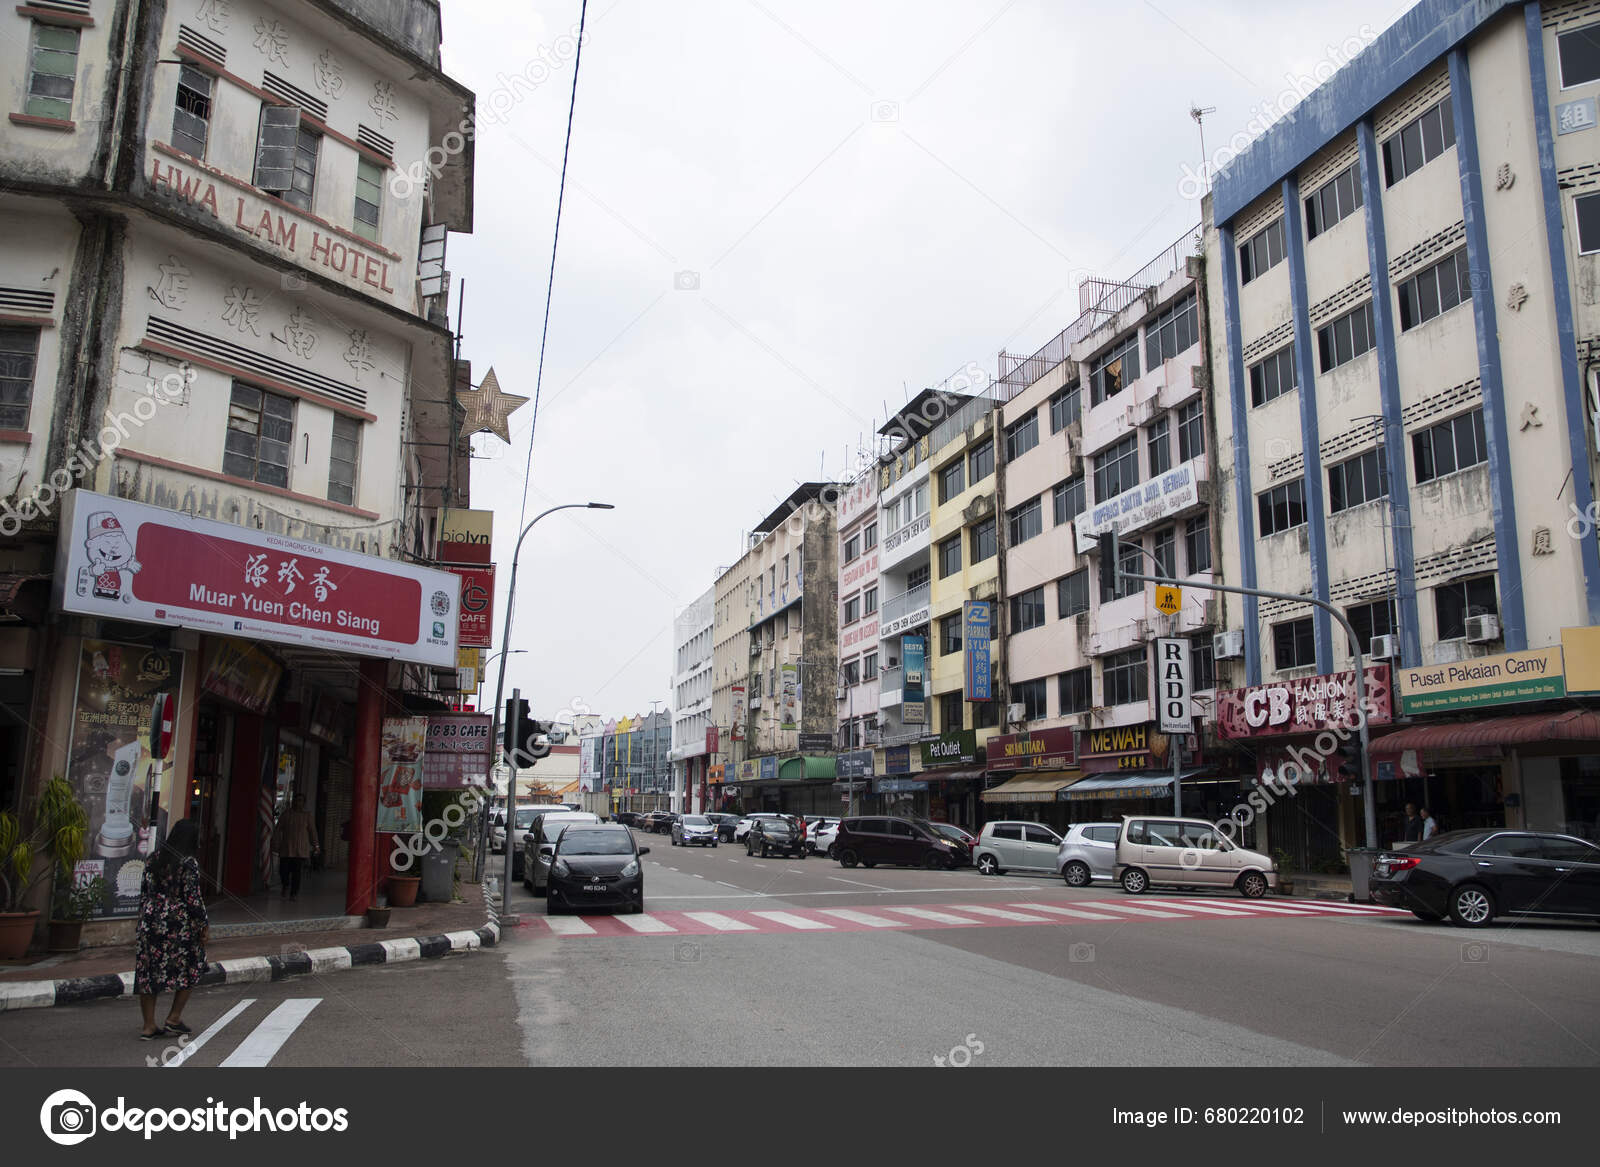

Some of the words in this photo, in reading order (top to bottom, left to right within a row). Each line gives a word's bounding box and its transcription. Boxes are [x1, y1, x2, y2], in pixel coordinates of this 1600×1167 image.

[150, 158, 219, 219] HWA
[236, 197, 300, 252] LAM
[310, 231, 395, 295] HOTEL
[266, 536, 284, 547] KEDAI
[284, 541, 308, 551] DAGING
[189, 583, 237, 609] Muar
[241, 592, 284, 616] Yuen
[288, 601, 332, 624] Chen
[336, 610, 380, 635] Siang
[460, 614, 487, 623] CAFE
[1165, 643, 1184, 718] RADO
[1410, 671, 1445, 688] Pusat
[1448, 663, 1501, 683] Pakaian
[1505, 656, 1548, 674] Camy
[1295, 680, 1347, 703] FASHION
[1244, 687, 1292, 728] CB
[442, 725, 457, 736] 83
[460, 724, 489, 736] CAFE
[1162, 721, 1191, 730] Switzerland
[930, 742, 940, 757] Pet
[941, 740, 961, 756] Outlet
[1091, 726, 1146, 753] MEWAH
